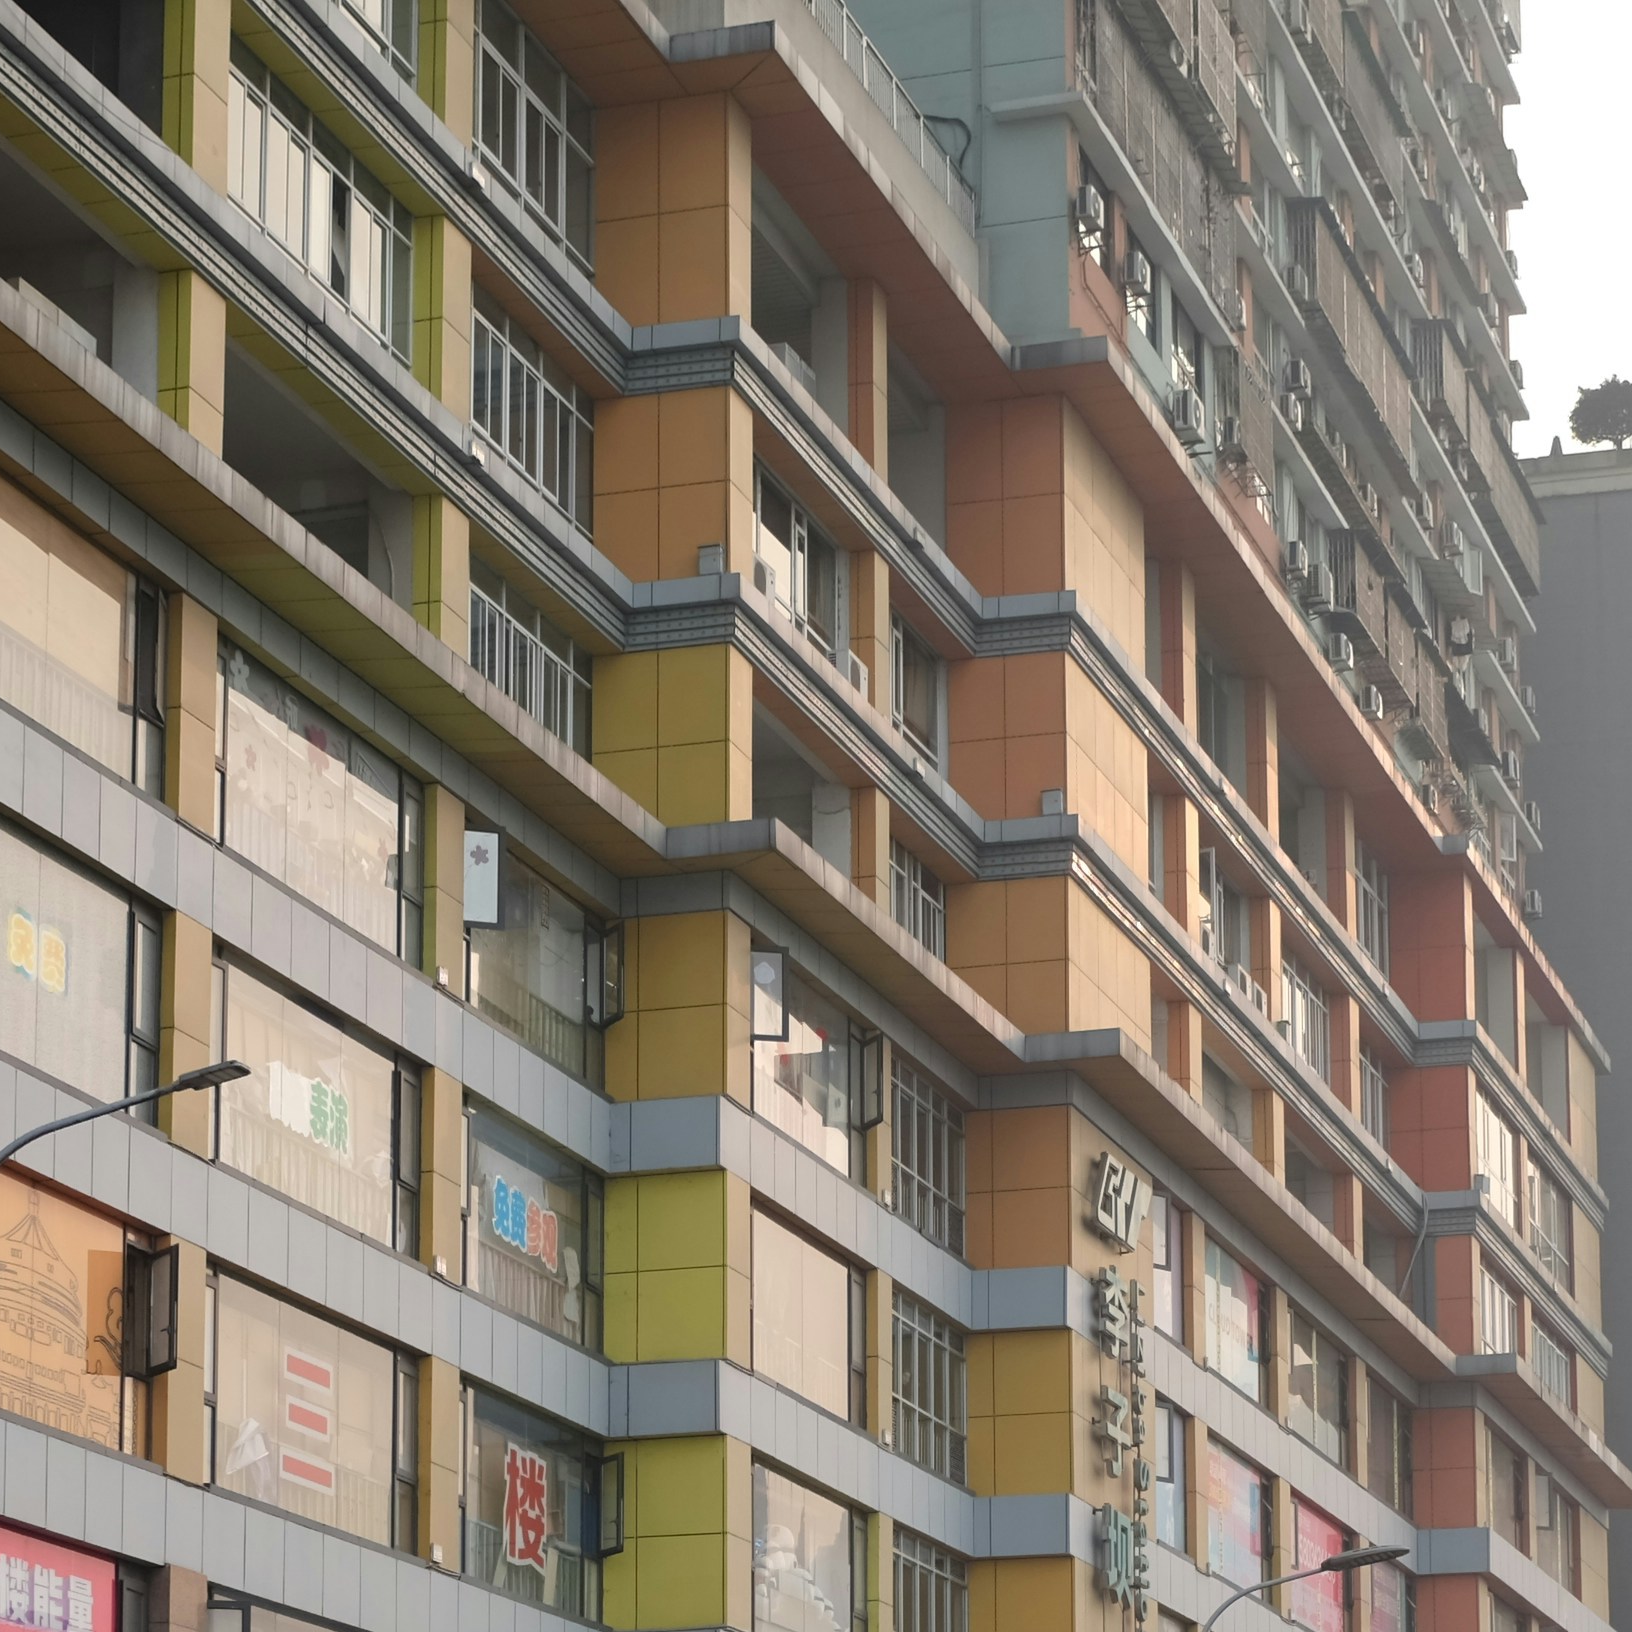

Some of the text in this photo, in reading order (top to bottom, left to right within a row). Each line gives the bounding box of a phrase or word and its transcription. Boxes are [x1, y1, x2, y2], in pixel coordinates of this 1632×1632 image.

[310, 1079, 350, 1153] 表演
[492, 1175, 559, 1272] 免费参观
[505, 1445, 547, 1577] 楼
